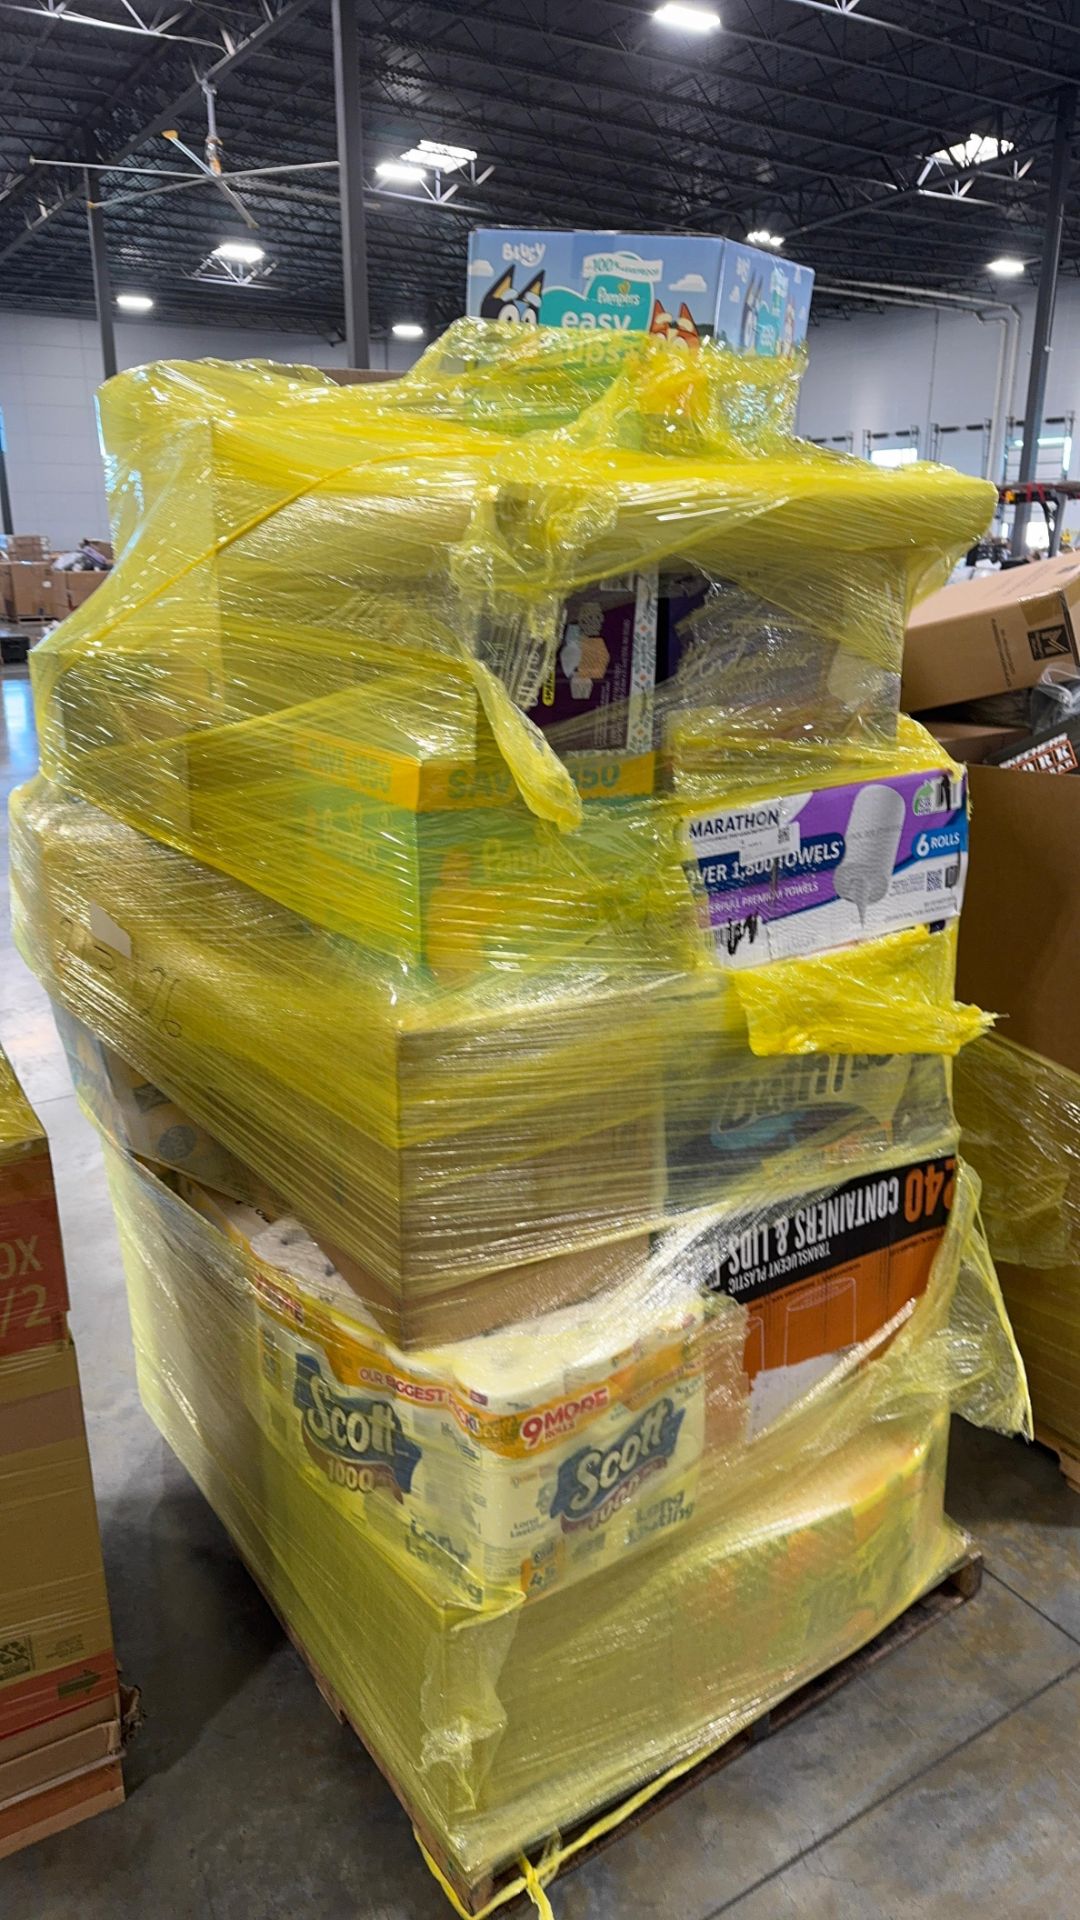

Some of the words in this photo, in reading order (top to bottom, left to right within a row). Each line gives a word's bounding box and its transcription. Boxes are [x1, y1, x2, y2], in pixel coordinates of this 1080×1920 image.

[561, 310, 632, 330] easy
[447, 764, 512, 801] SAV
[689, 808, 780, 839] MARATHON
[915, 833, 930, 857] 6
[930, 832, 961, 850] ROLLS
[794, 1175, 899, 1251] CONTAINERS
[727, 1221, 769, 1275] LIDS
[773, 1218, 790, 1260] &
[768, 1239, 832, 1278] TRANSLUCENT
[726, 1264, 768, 1294] PLASTIC
[360, 1367, 384, 1386] OUR
[385, 1374, 446, 1403] BIGGEST
[307, 1375, 397, 1457] Scott
[521, 1417, 543, 1449] 9
[544, 1388, 609, 1432] MORE
[568, 1401, 669, 1512] Scott
[326, 1458, 375, 1494] 1000
